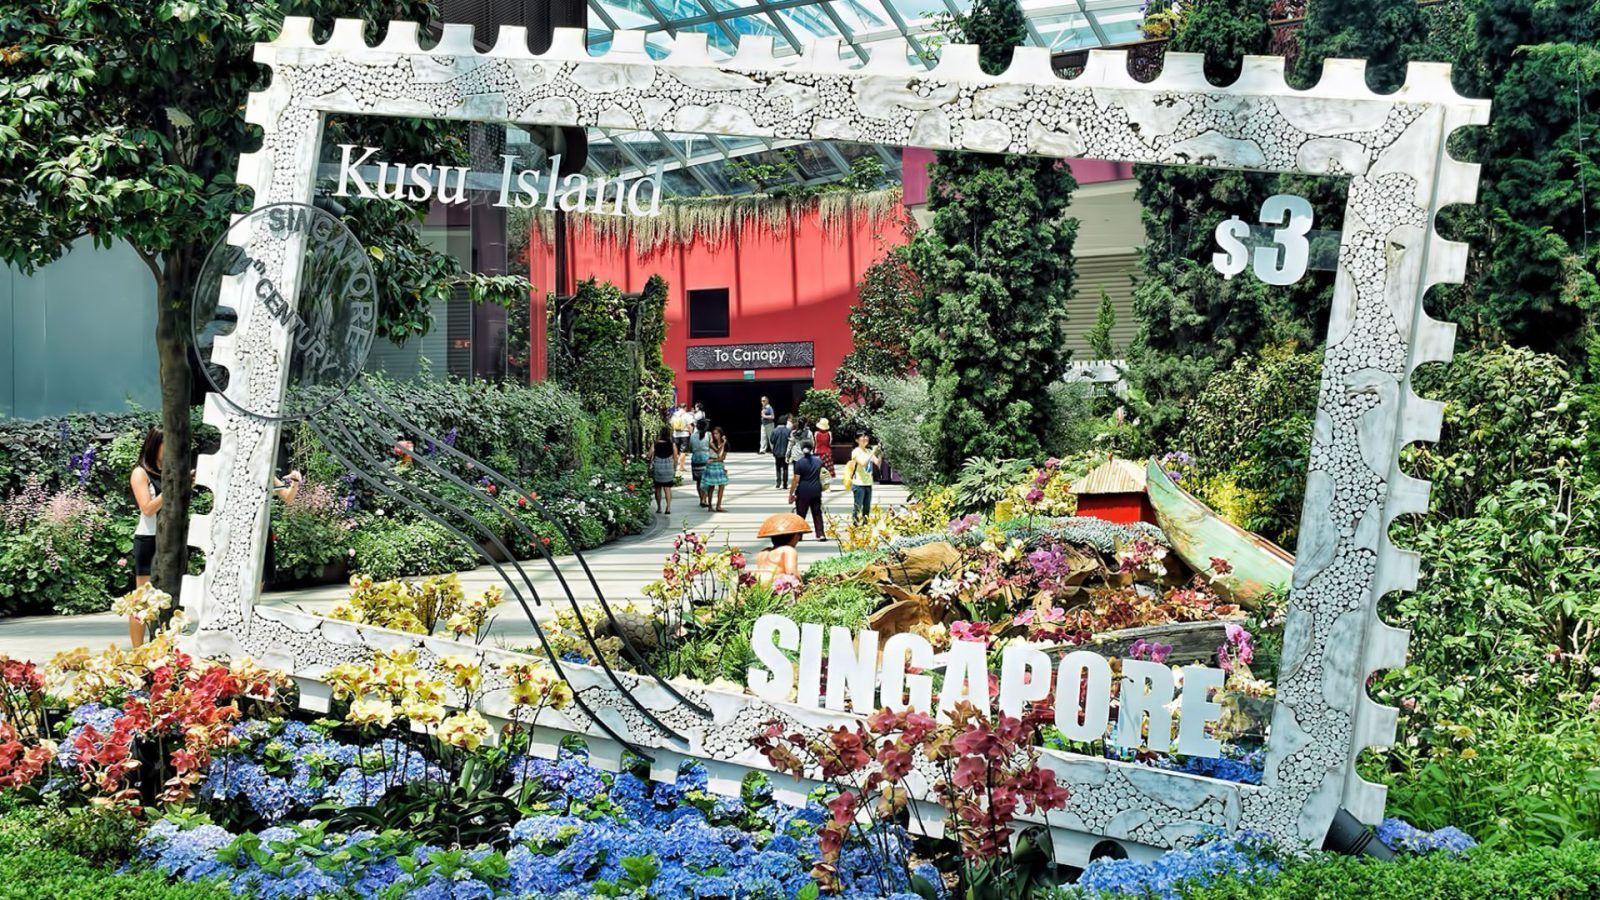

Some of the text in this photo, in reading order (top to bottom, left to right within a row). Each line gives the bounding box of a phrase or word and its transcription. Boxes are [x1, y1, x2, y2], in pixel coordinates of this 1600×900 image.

[331, 143, 665, 218] Kusu Island
[267, 207, 371, 351] SINGAPORE
[1212, 194, 1314, 286] $3
[255, 278, 340, 375] CENTURY
[714, 348, 786, 364] To Canopy
[747, 614, 1226, 759] SINGAPORE
